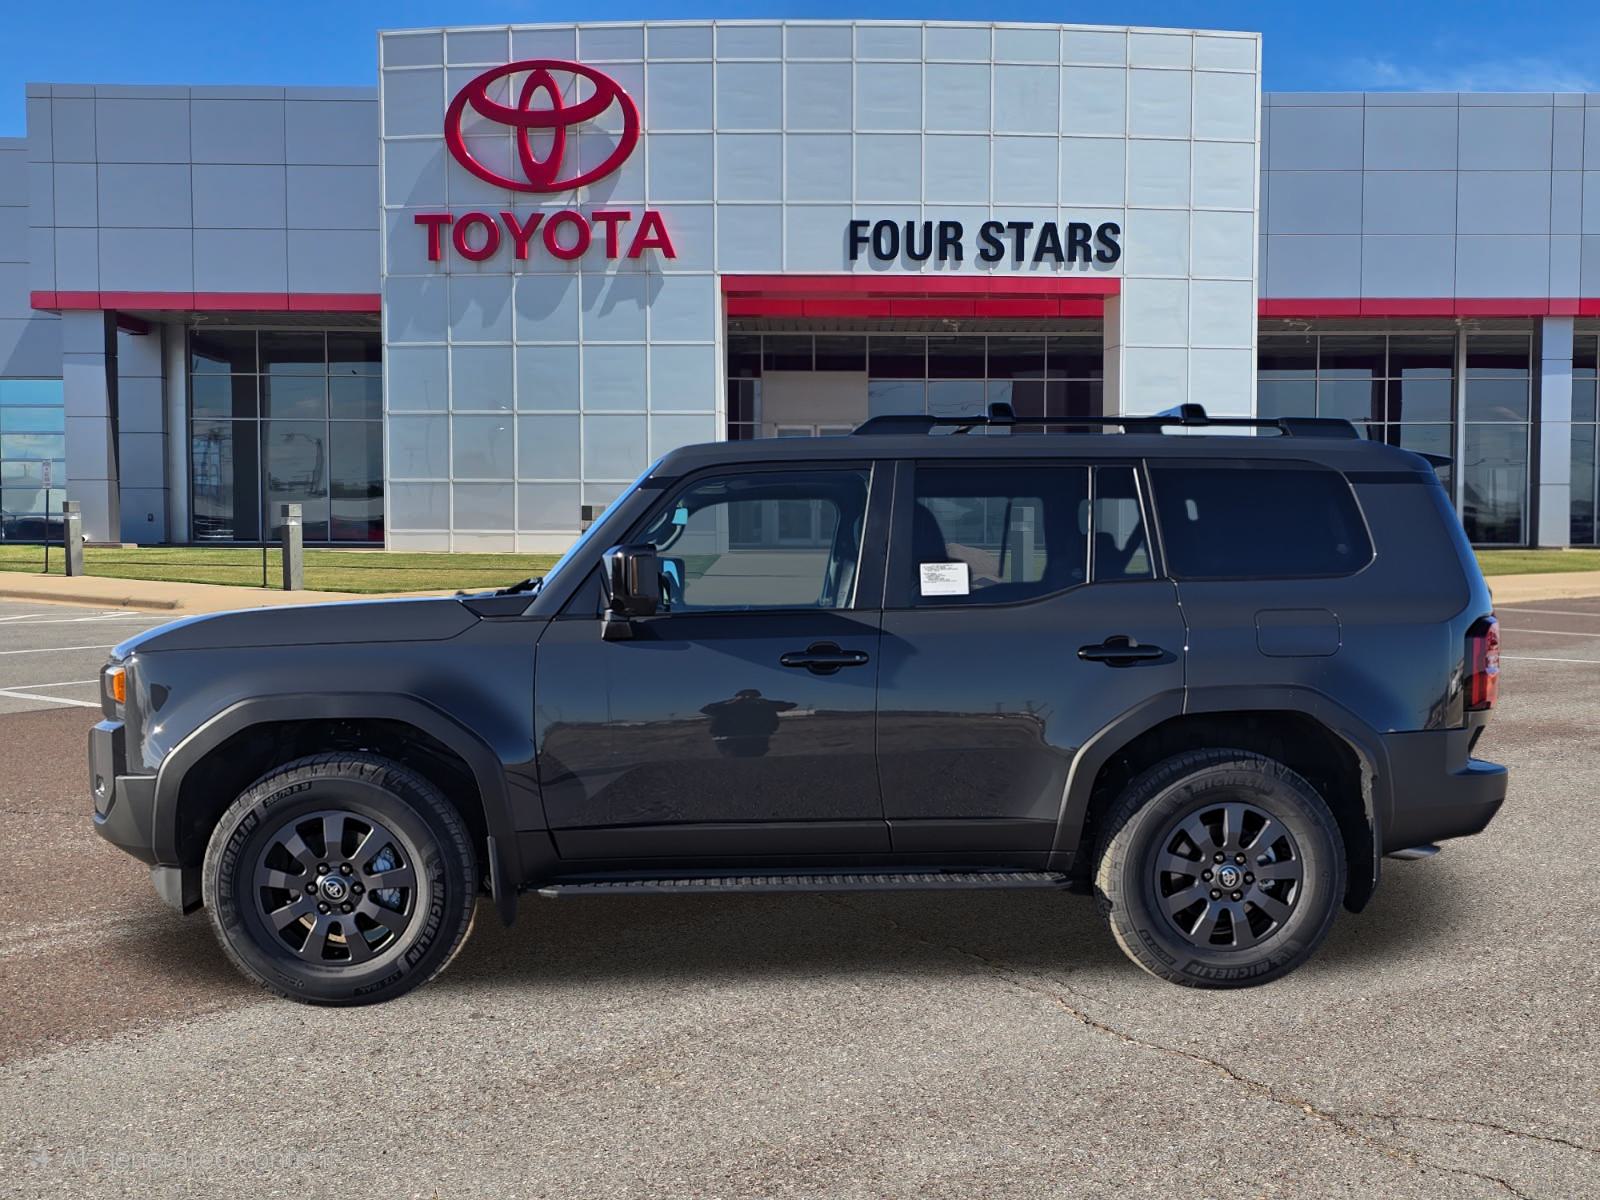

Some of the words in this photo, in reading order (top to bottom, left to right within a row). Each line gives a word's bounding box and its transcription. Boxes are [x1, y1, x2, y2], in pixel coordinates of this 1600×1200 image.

[414, 210, 676, 262] TOYOTA
[849, 219, 963, 261] FOUR
[979, 220, 1121, 263] STARS
[220, 813, 257, 897] MICHELIN
[406, 881, 445, 966] MICHELIN
[1187, 960, 1270, 979] MICHELIN
